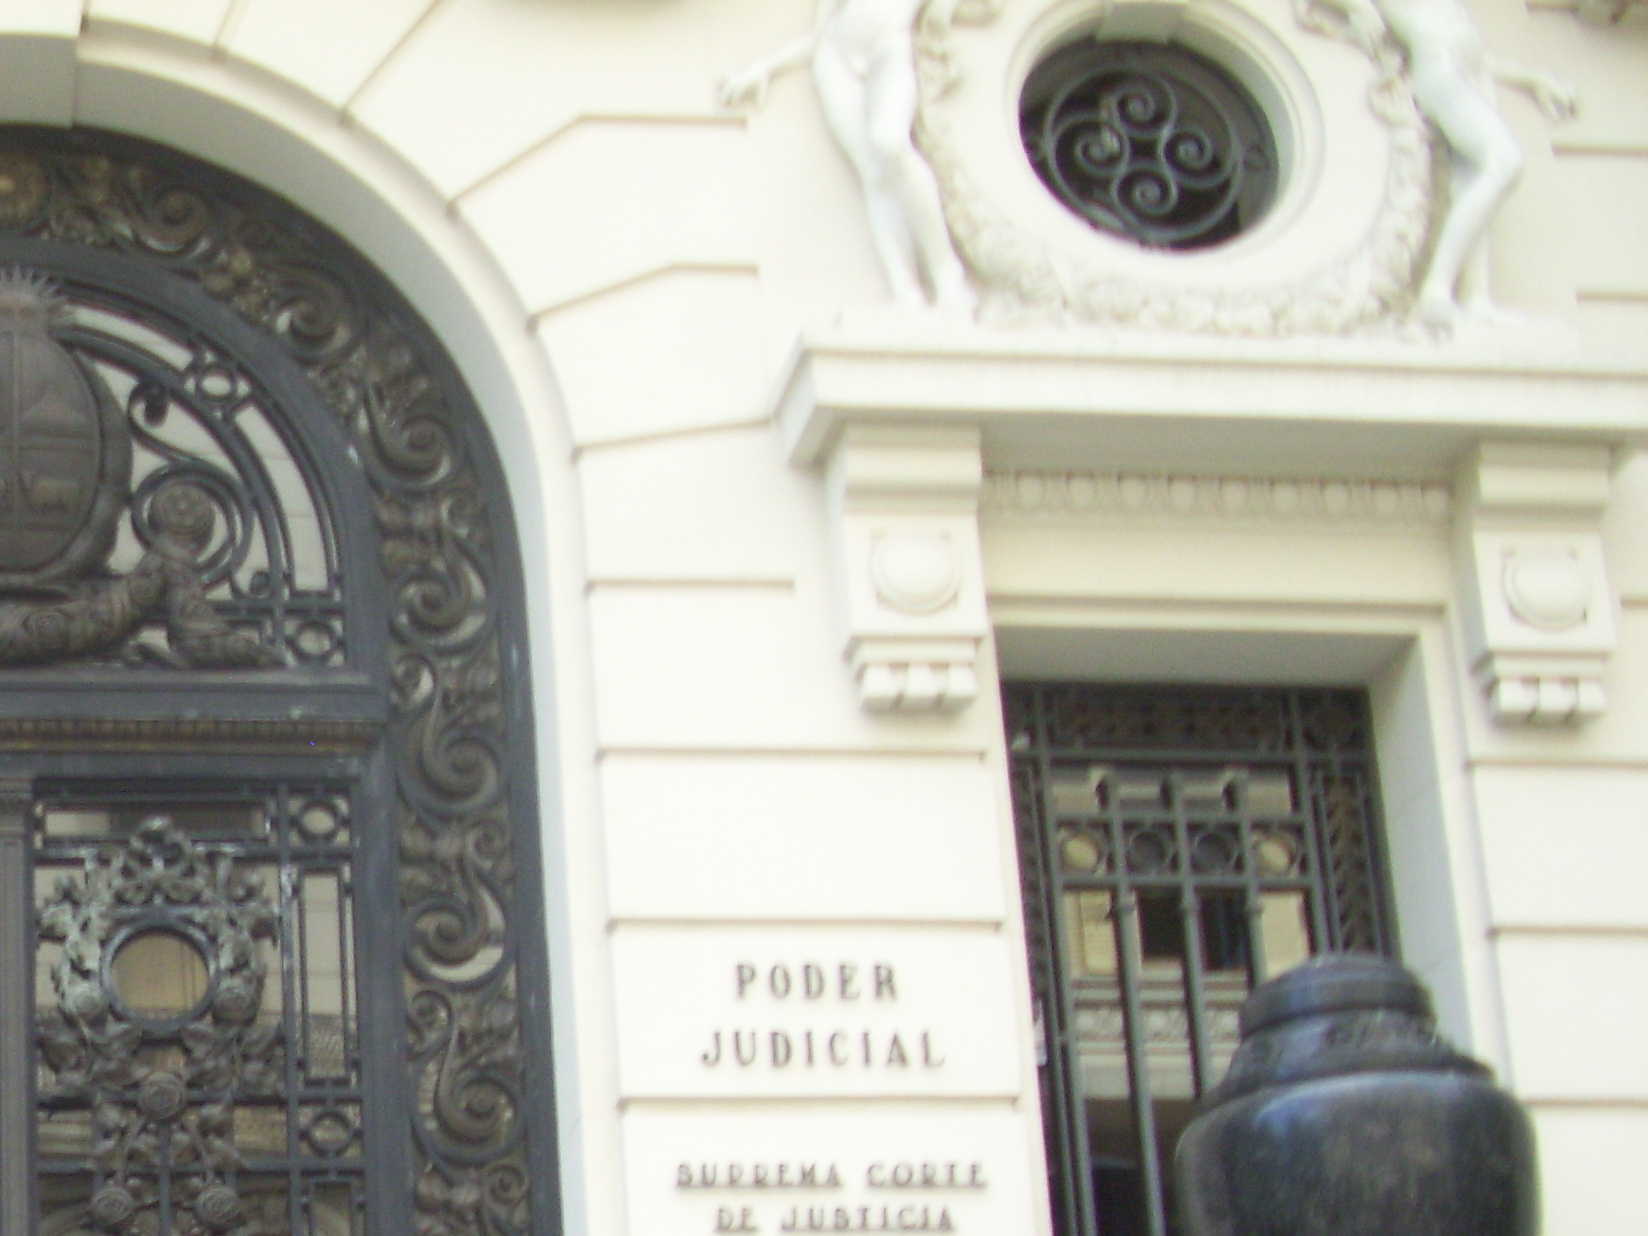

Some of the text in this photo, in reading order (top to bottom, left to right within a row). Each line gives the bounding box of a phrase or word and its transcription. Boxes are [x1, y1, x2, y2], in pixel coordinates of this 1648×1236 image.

[734, 962, 897, 1001] PODER
[701, 1030, 945, 1068] JUDICIAL
[675, 1162, 987, 1190] SUPREMA CORTE
[713, 1206, 956, 1233] DE JUSTICIA
